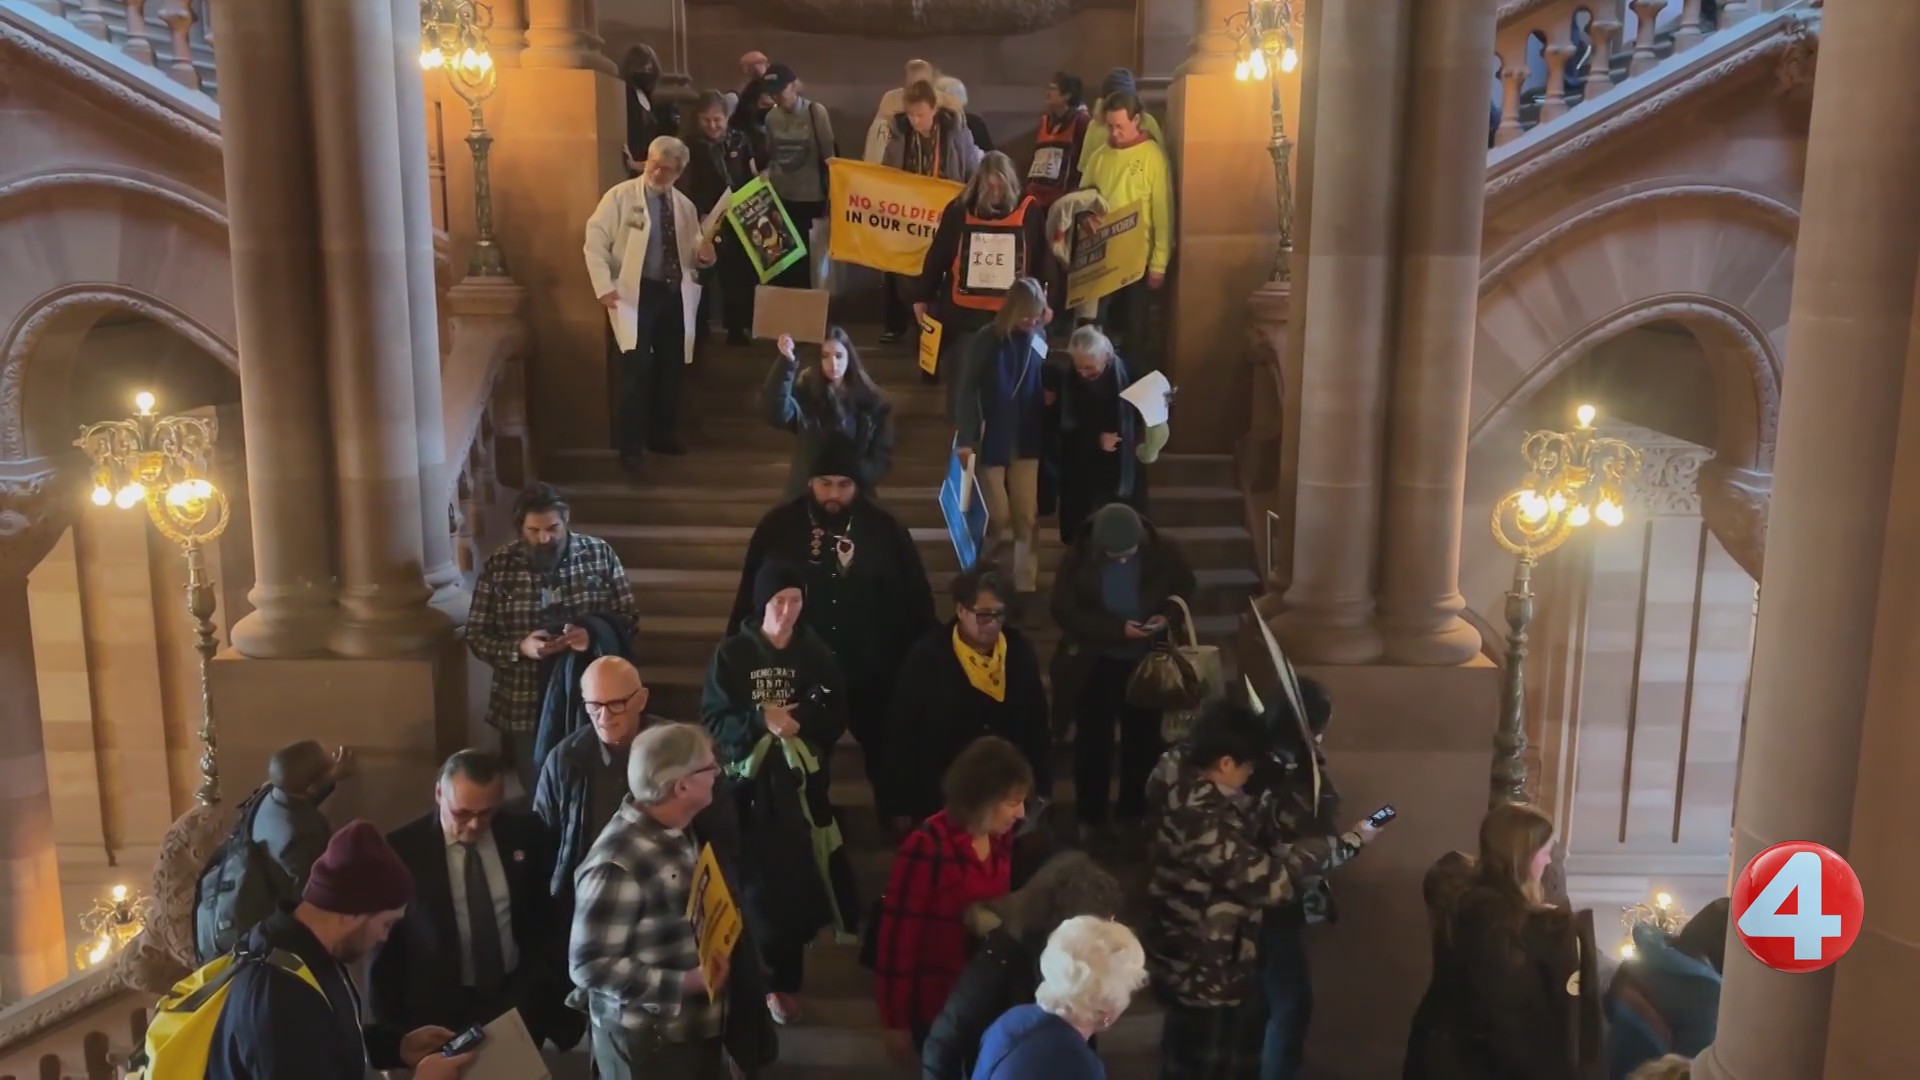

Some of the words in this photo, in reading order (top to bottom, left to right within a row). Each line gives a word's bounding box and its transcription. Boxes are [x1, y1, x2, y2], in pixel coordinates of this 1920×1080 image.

[848, 194, 872, 210] NO
[846, 210, 862, 224] IN
[869, 215, 900, 231] OUR
[1111, 215, 1136, 235] YORK
[973, 251, 1004, 266] ICE
[751, 689, 795, 700] SPECATO
